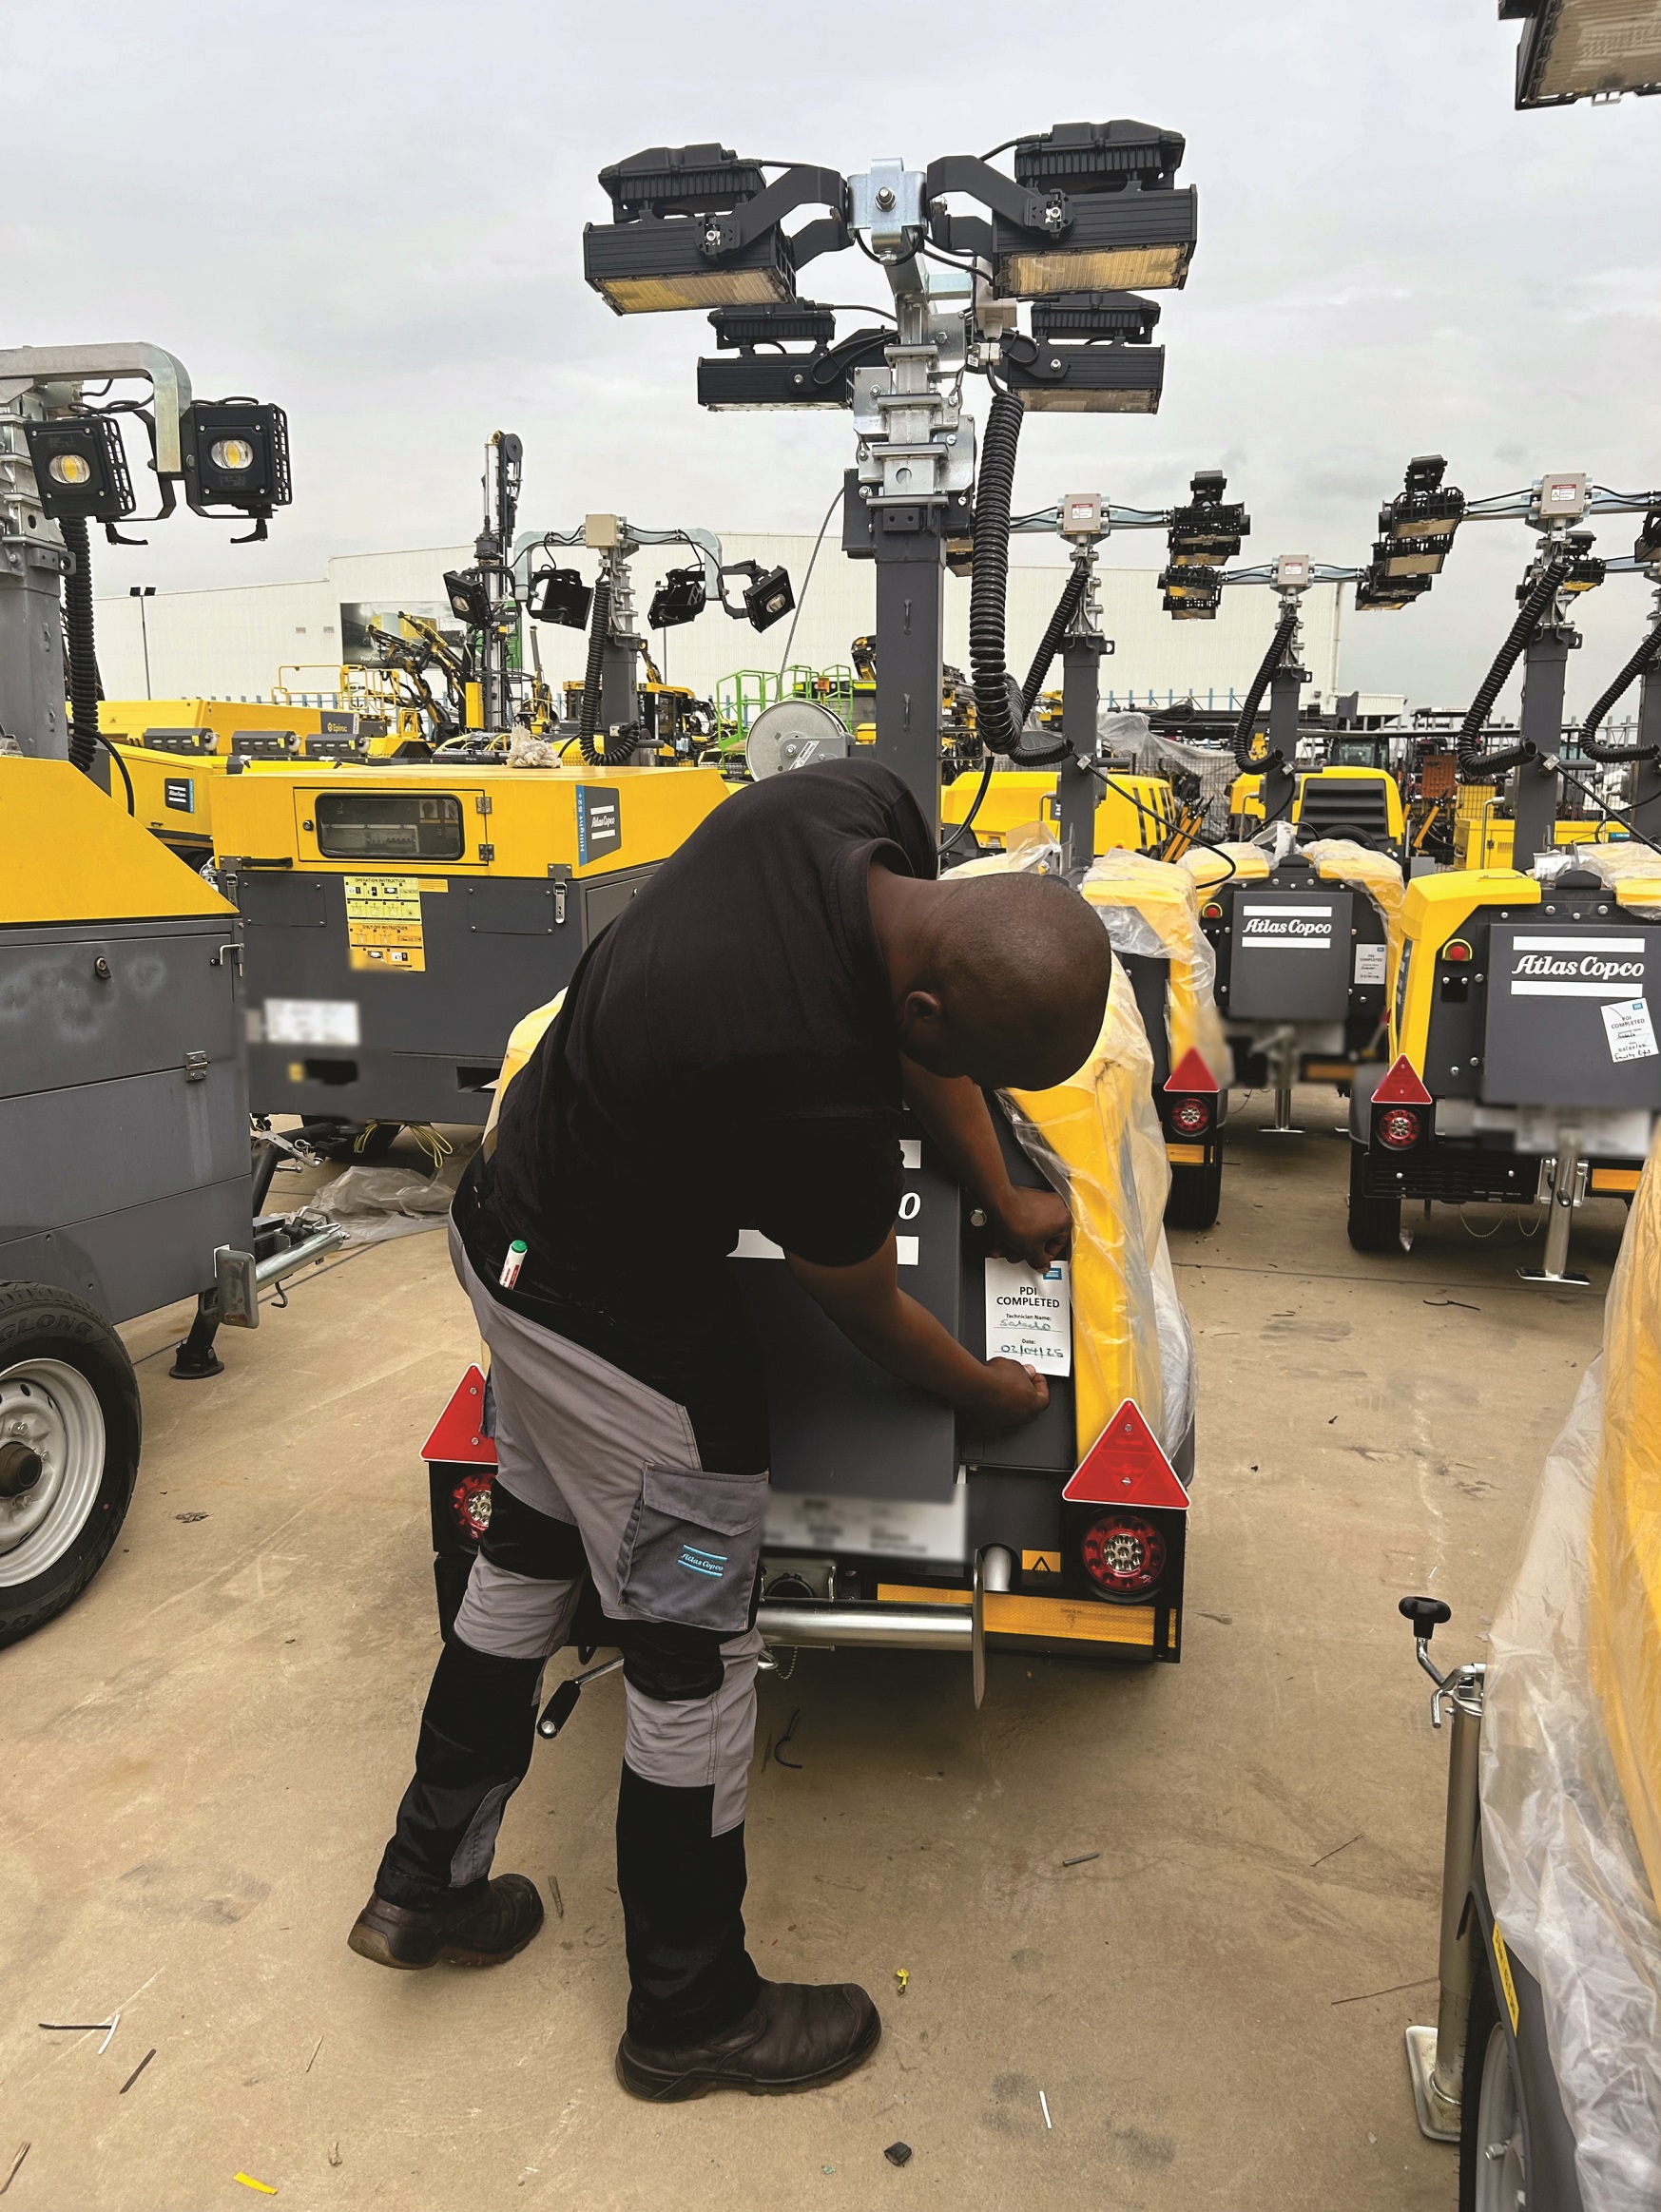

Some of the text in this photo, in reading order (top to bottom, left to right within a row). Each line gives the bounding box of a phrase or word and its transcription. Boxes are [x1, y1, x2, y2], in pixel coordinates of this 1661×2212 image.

[590, 815, 615, 828] Atlas Copco
[1242, 918, 1332, 936] Atlas Copco
[1511, 954, 1645, 980] Atlas Copco
[1611, 1018, 1646, 1029] COMPLETED
[1019, 1286, 1037, 1296] PDI
[996, 1297, 1060, 1308] COMPLETED
[680, 1553, 724, 1571] Atlas Copco
